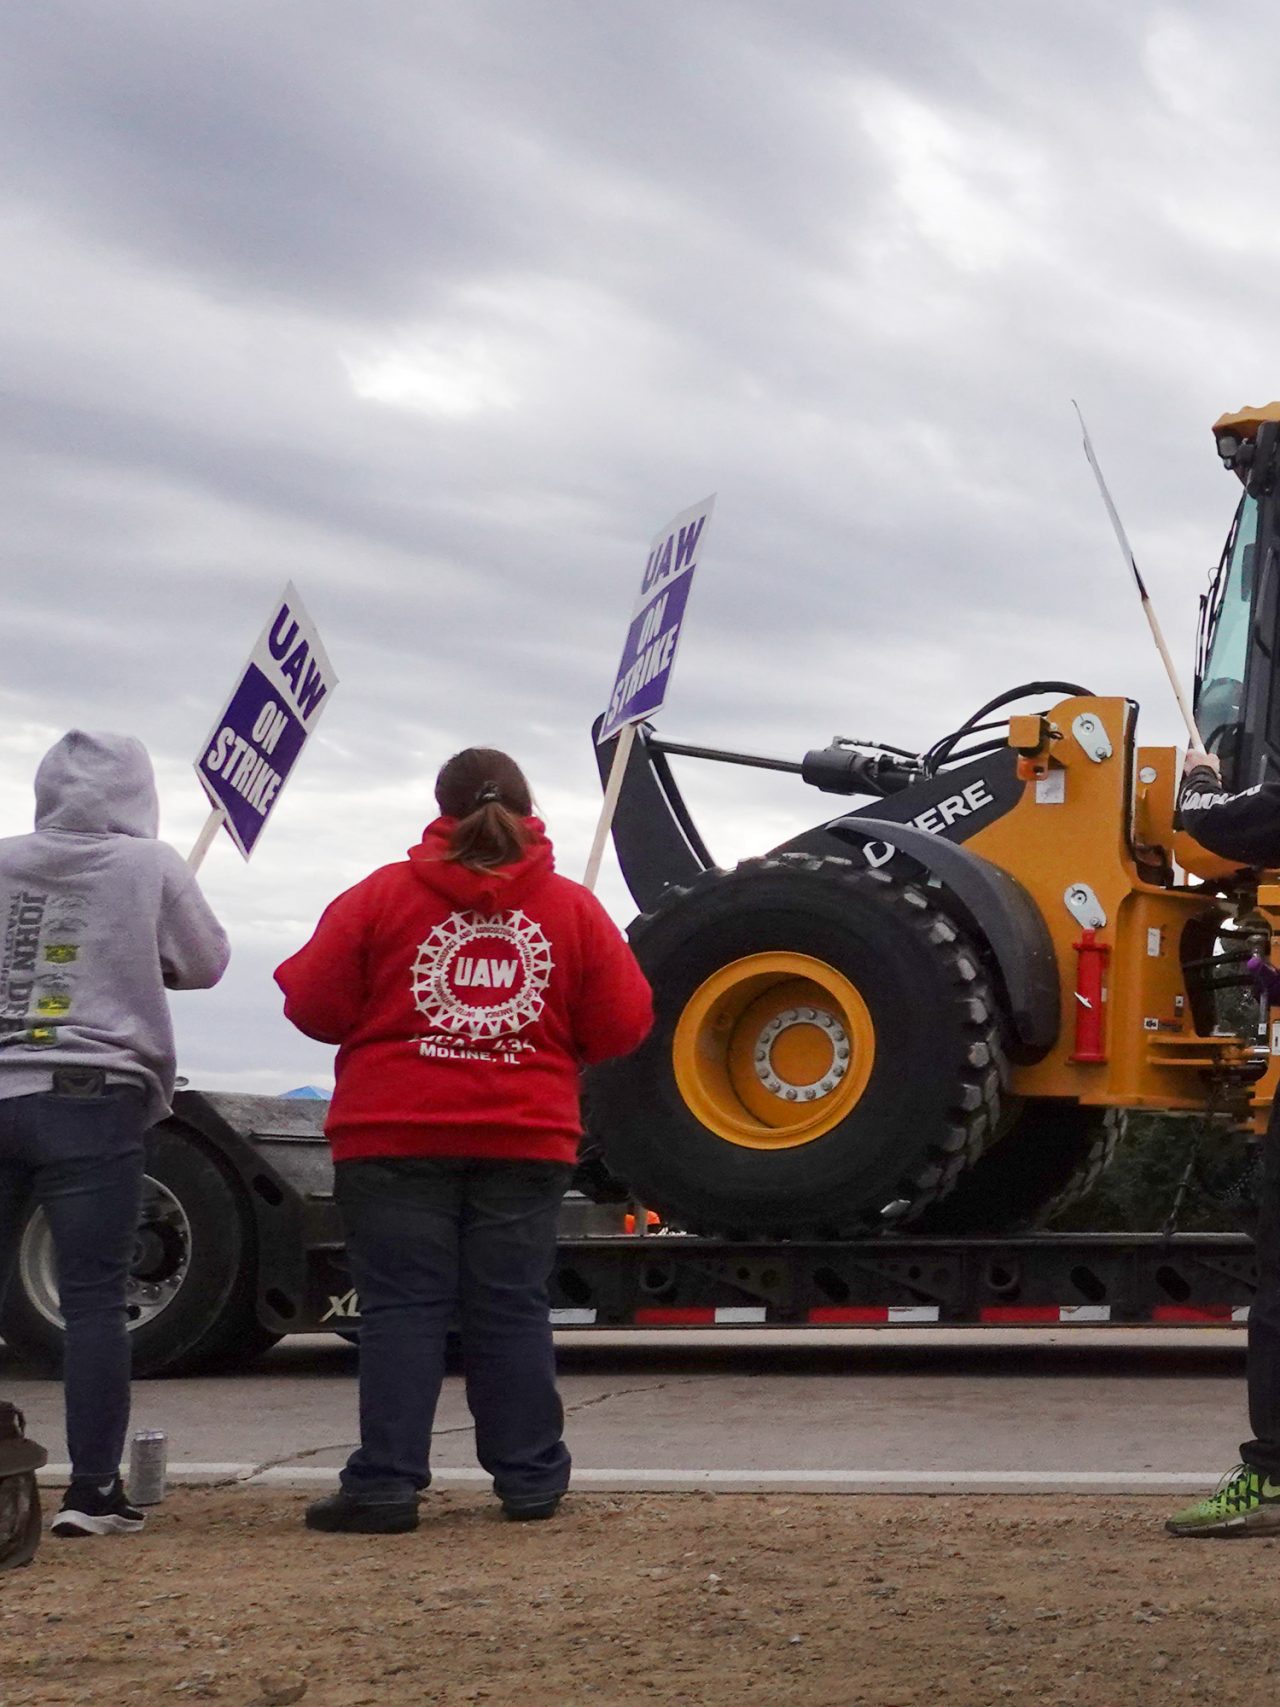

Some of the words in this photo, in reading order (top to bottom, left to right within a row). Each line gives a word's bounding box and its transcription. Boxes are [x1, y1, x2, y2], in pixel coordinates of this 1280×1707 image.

[640, 514, 707, 596] UAW
[268, 602, 328, 722] UAW
[636, 591, 670, 655] ON
[606, 622, 679, 726] STRIKE
[252, 700, 289, 753] ON
[206, 725, 283, 816] STRIKE
[862, 779, 995, 869] DERE
[12, 891, 48, 972] JOHN
[453, 956, 519, 989] UAW
[503, 1052, 521, 1065] IL
[318, 1287, 362, 1324] XL
